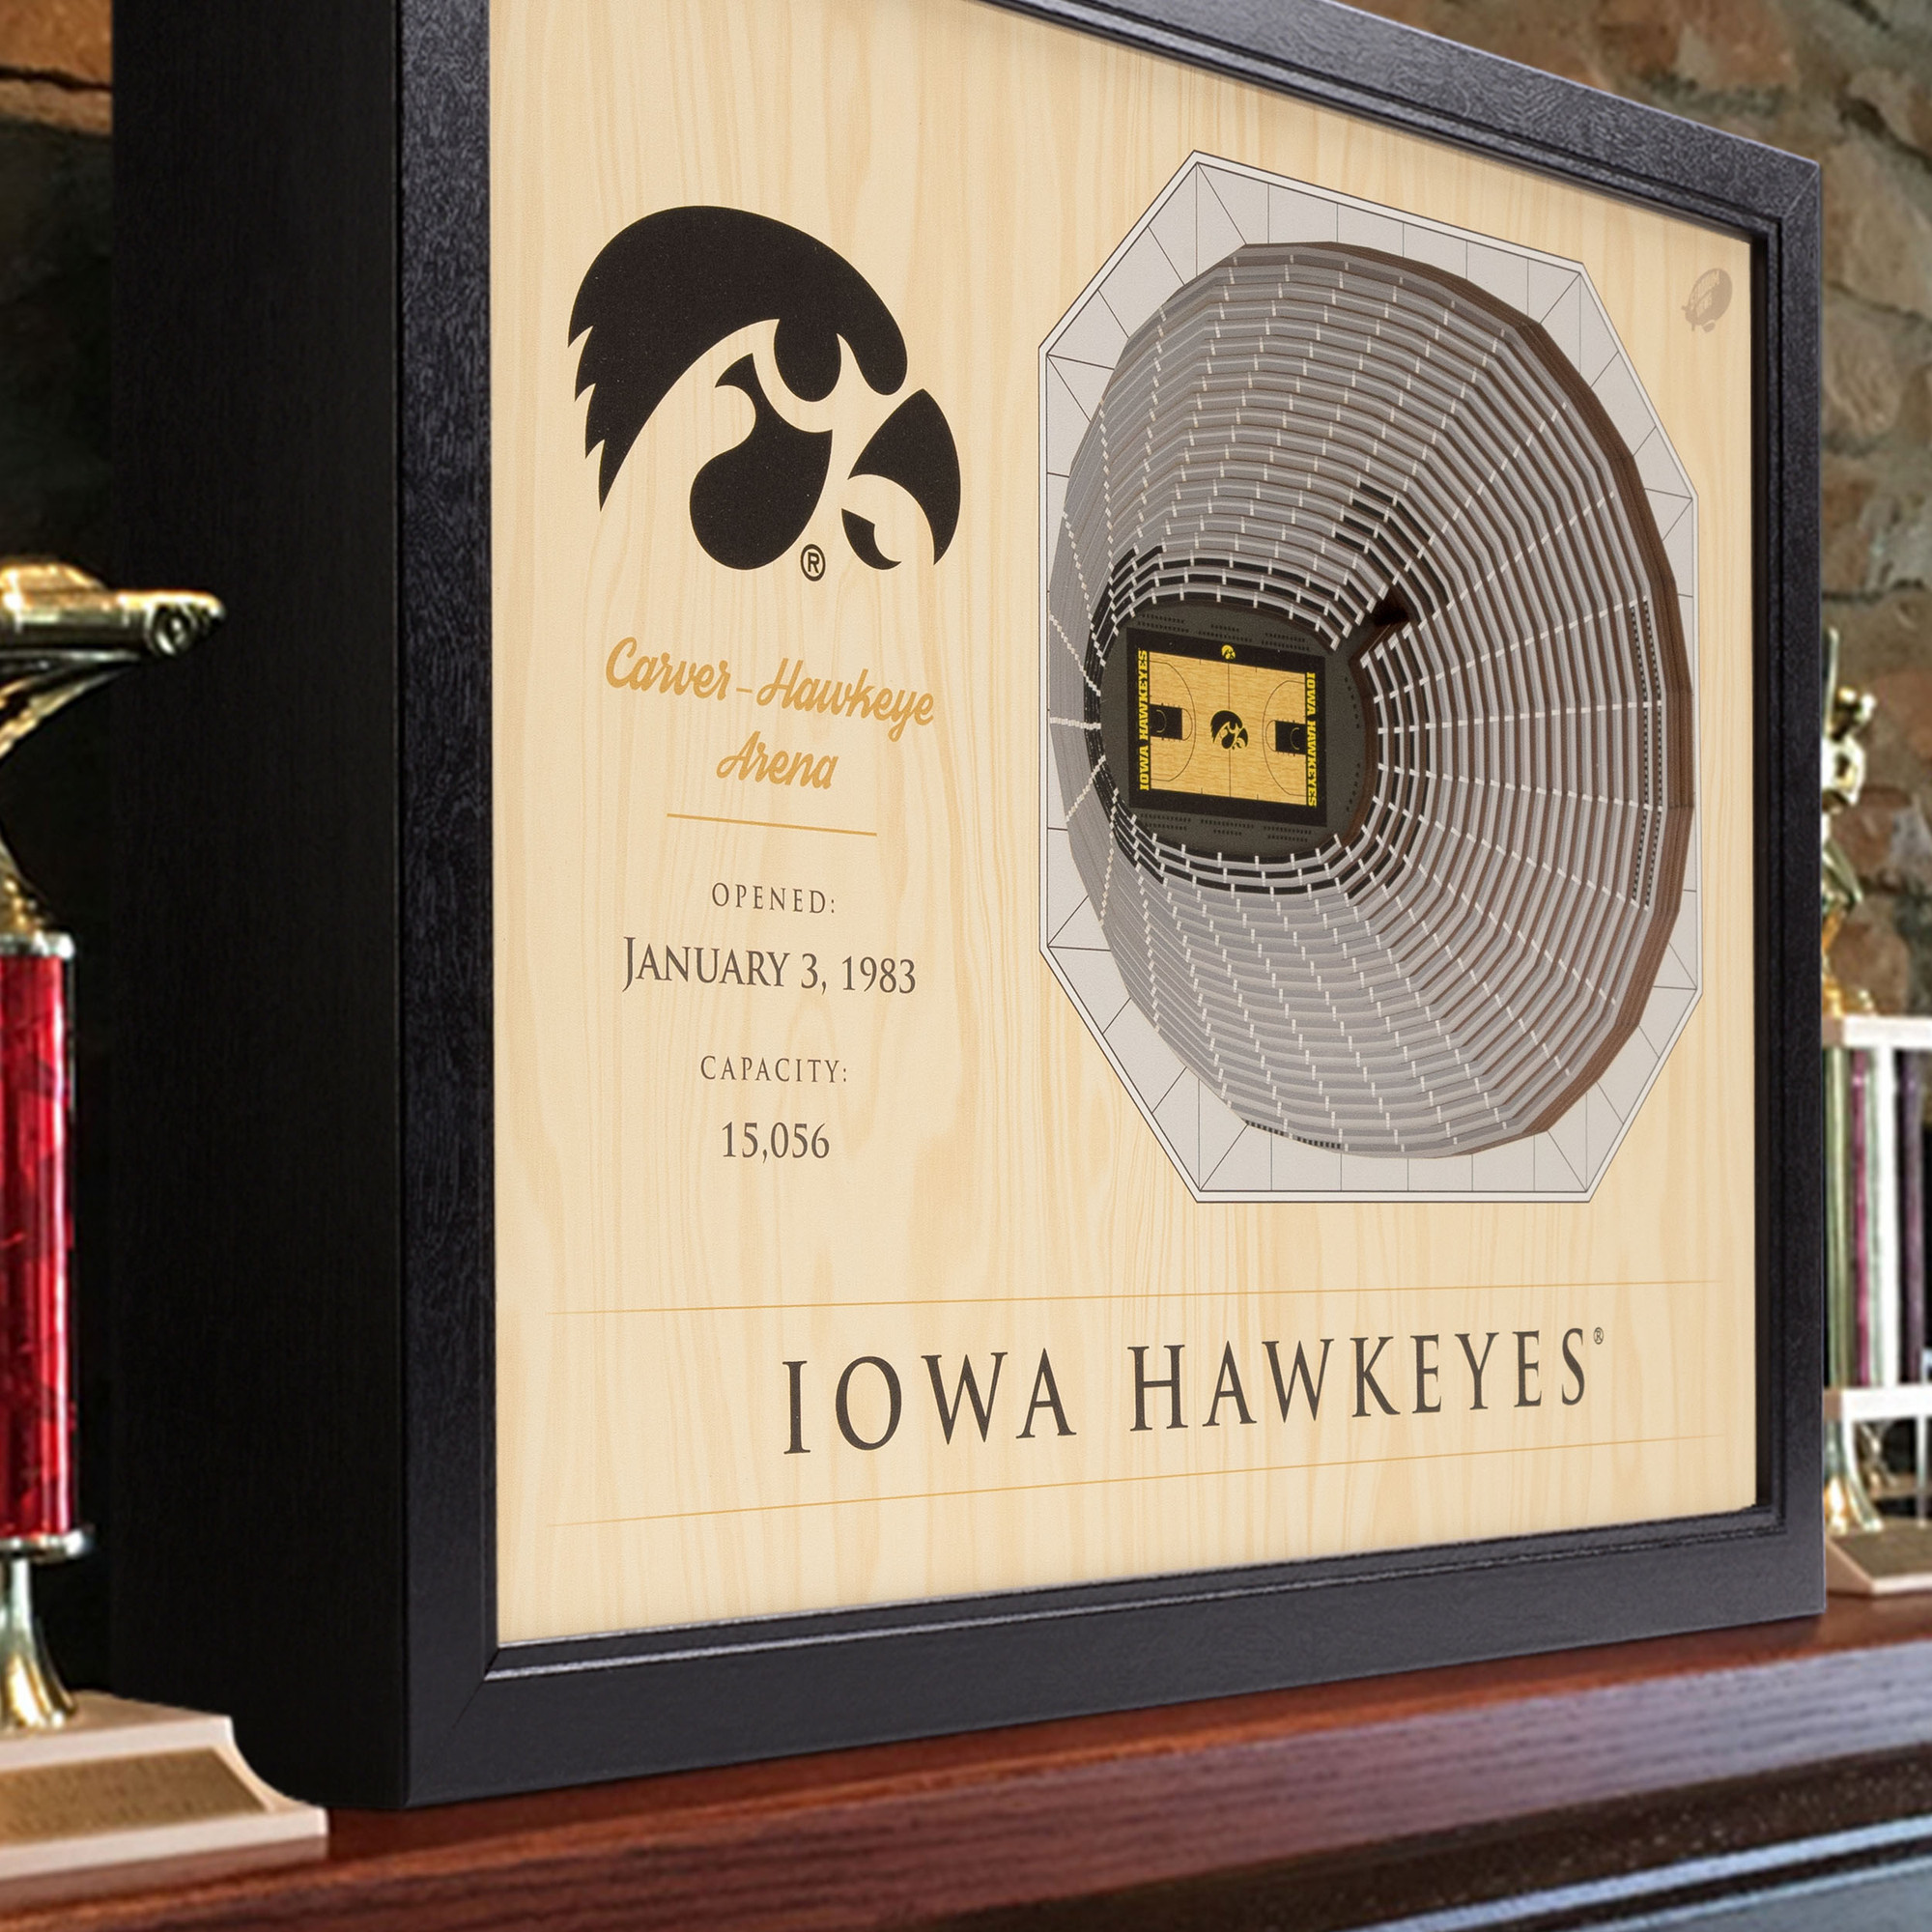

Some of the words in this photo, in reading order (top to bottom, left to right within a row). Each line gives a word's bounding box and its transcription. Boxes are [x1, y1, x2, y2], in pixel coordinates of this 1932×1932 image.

[1137, 649, 1149, 741] HAWKEYES
[1306, 671, 1317, 716] IOWA
[716, 730, 838, 789] Arena
[1138, 745, 1150, 791] IOWA
[1307, 719, 1318, 808] HAWKEYES
[712, 882, 835, 914] OPENED:
[801, 952, 827, 995] 3,
[841, 955, 916, 994] 1983
[700, 1055, 847, 1083] CAPACITY:
[722, 1122, 830, 1163] 15,056
[782, 1348, 1077, 1455] IOWA
